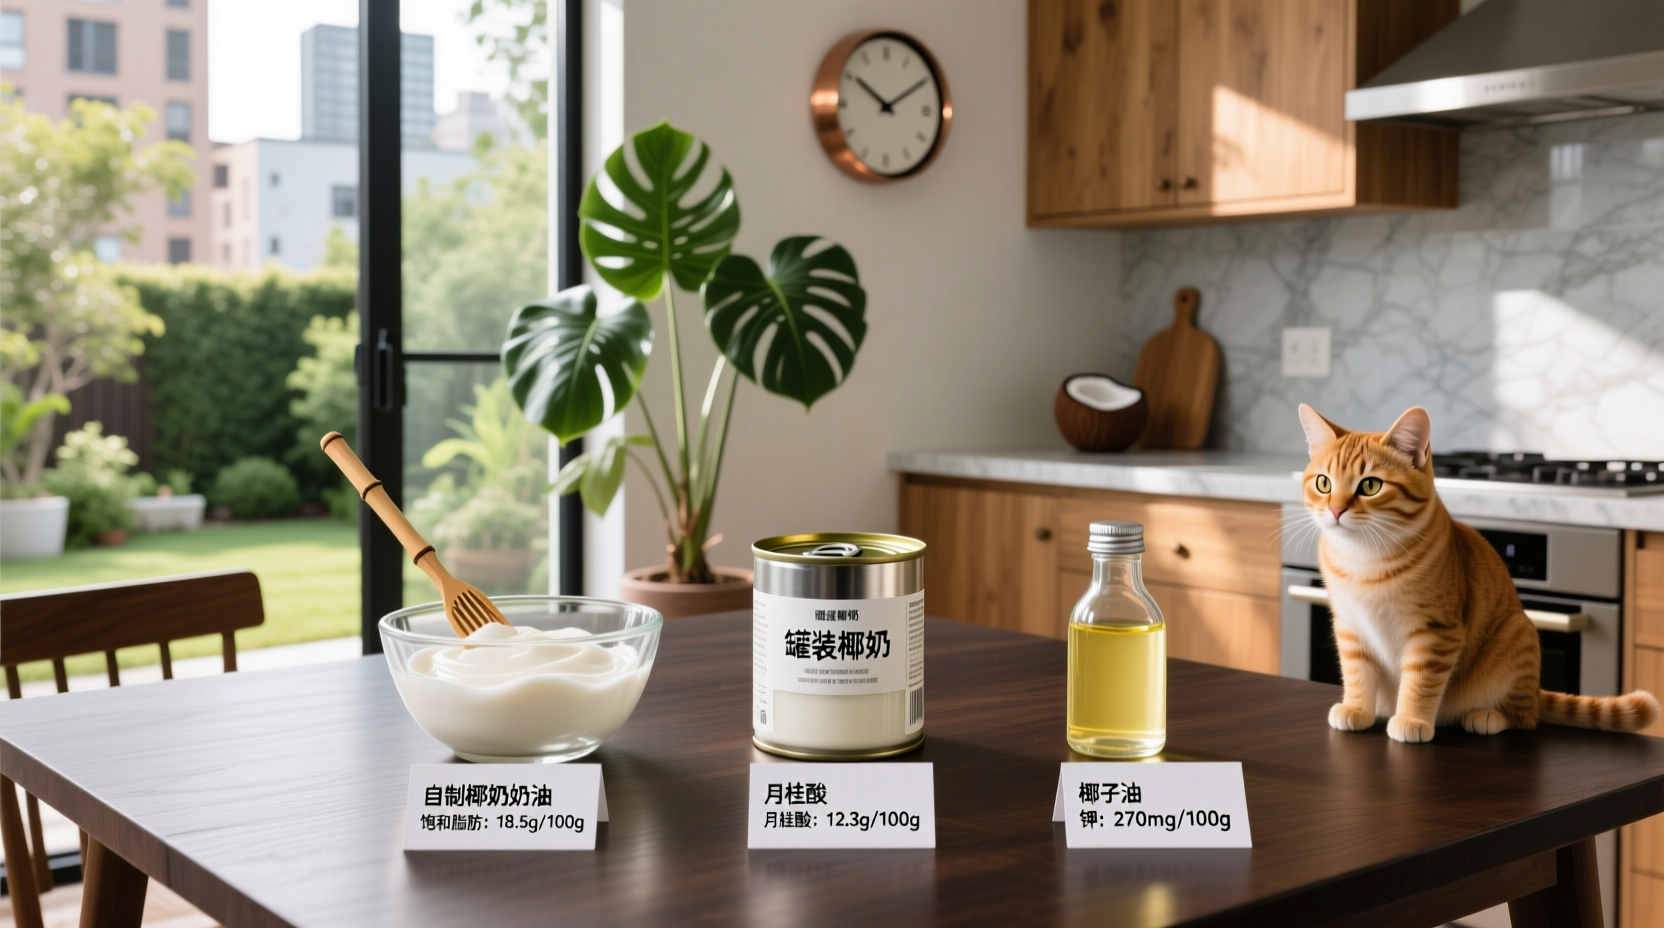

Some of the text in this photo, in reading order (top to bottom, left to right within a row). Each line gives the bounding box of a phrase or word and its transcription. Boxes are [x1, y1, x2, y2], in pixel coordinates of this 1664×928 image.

[785, 629, 891, 661] 罐装椰奶
[425, 783, 552, 807] 自制椰奶奶油
[764, 782, 827, 805] 月桂酸
[1079, 782, 1142, 805] 椰子油
